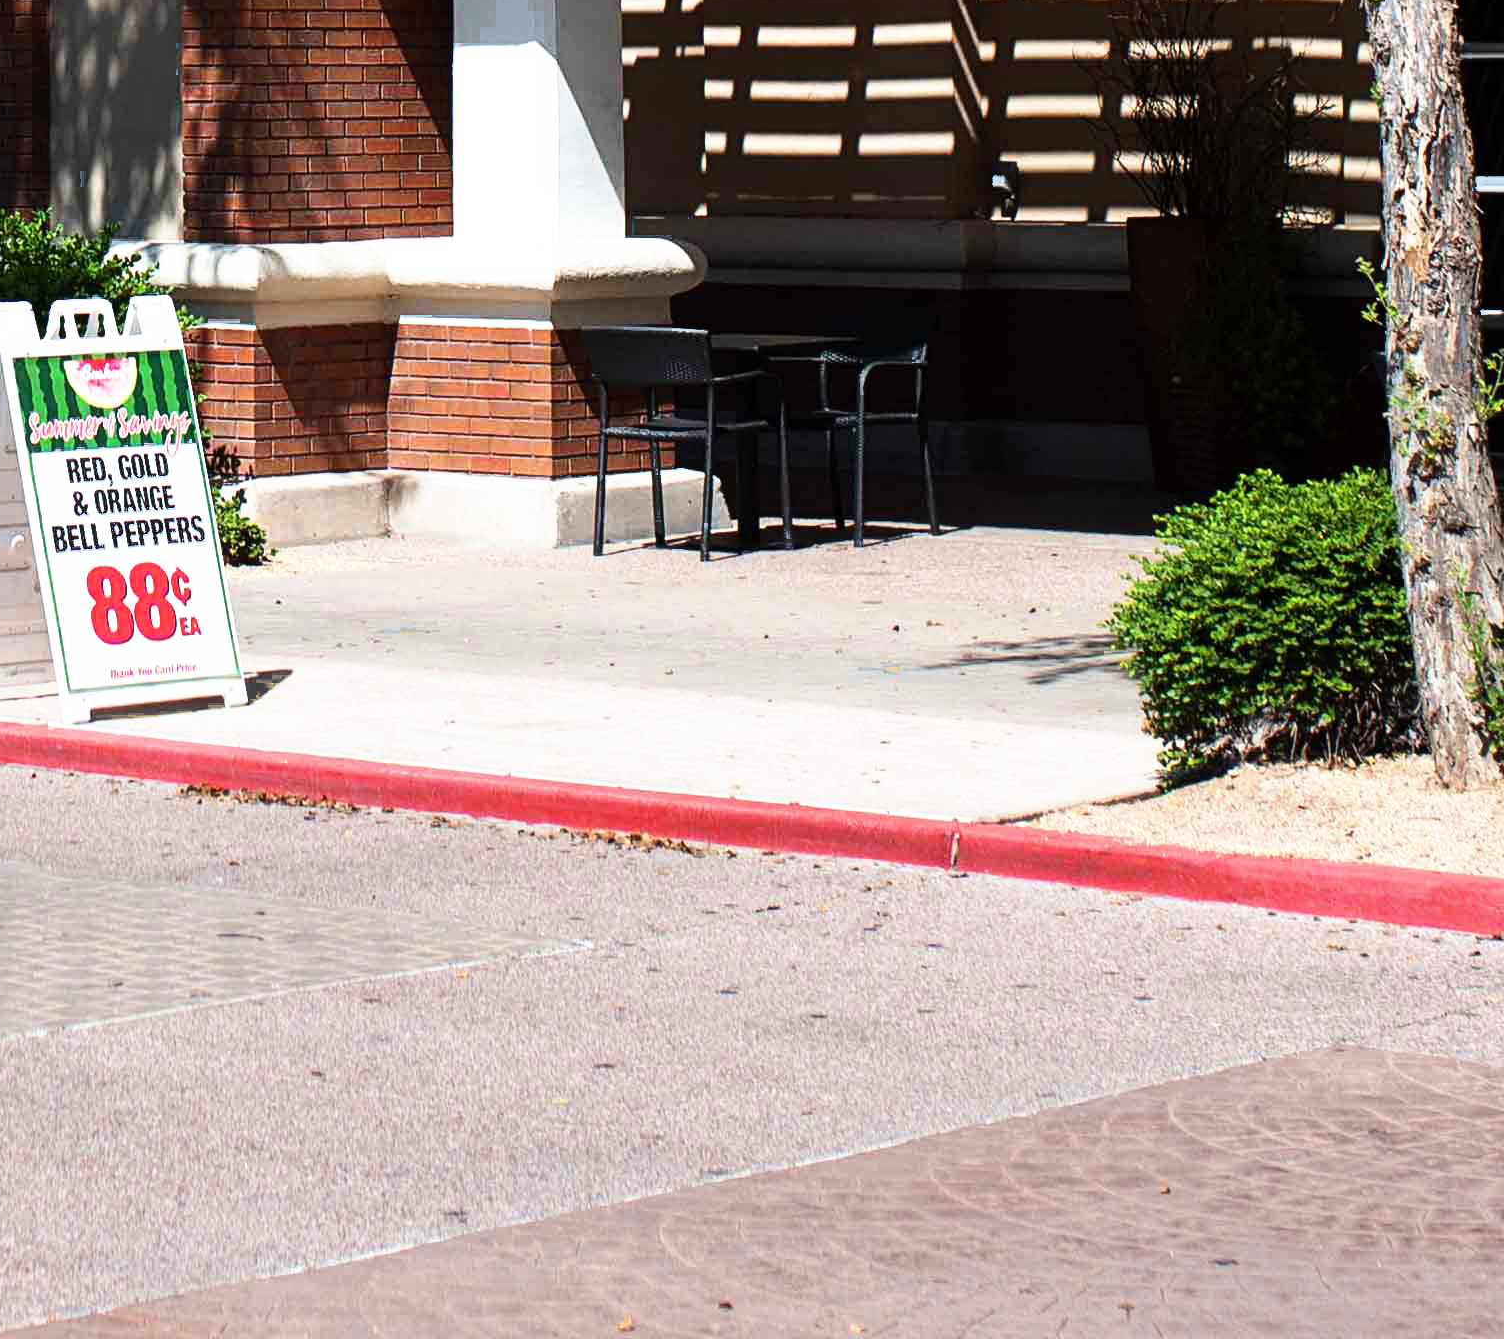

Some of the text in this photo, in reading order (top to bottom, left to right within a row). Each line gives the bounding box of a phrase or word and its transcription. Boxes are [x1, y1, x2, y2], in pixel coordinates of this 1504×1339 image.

[28, 411, 104, 445] Summer
[117, 407, 192, 457] Savings
[66, 453, 170, 486] RED, GOLD
[73, 485, 176, 516] & ORANGE
[52, 515, 206, 553] BELL PEPPERS
[179, 616, 202, 636] EA
[110, 667, 134, 679] Thank
[138, 666, 152, 676] You
[176, 663, 197, 674] Price
